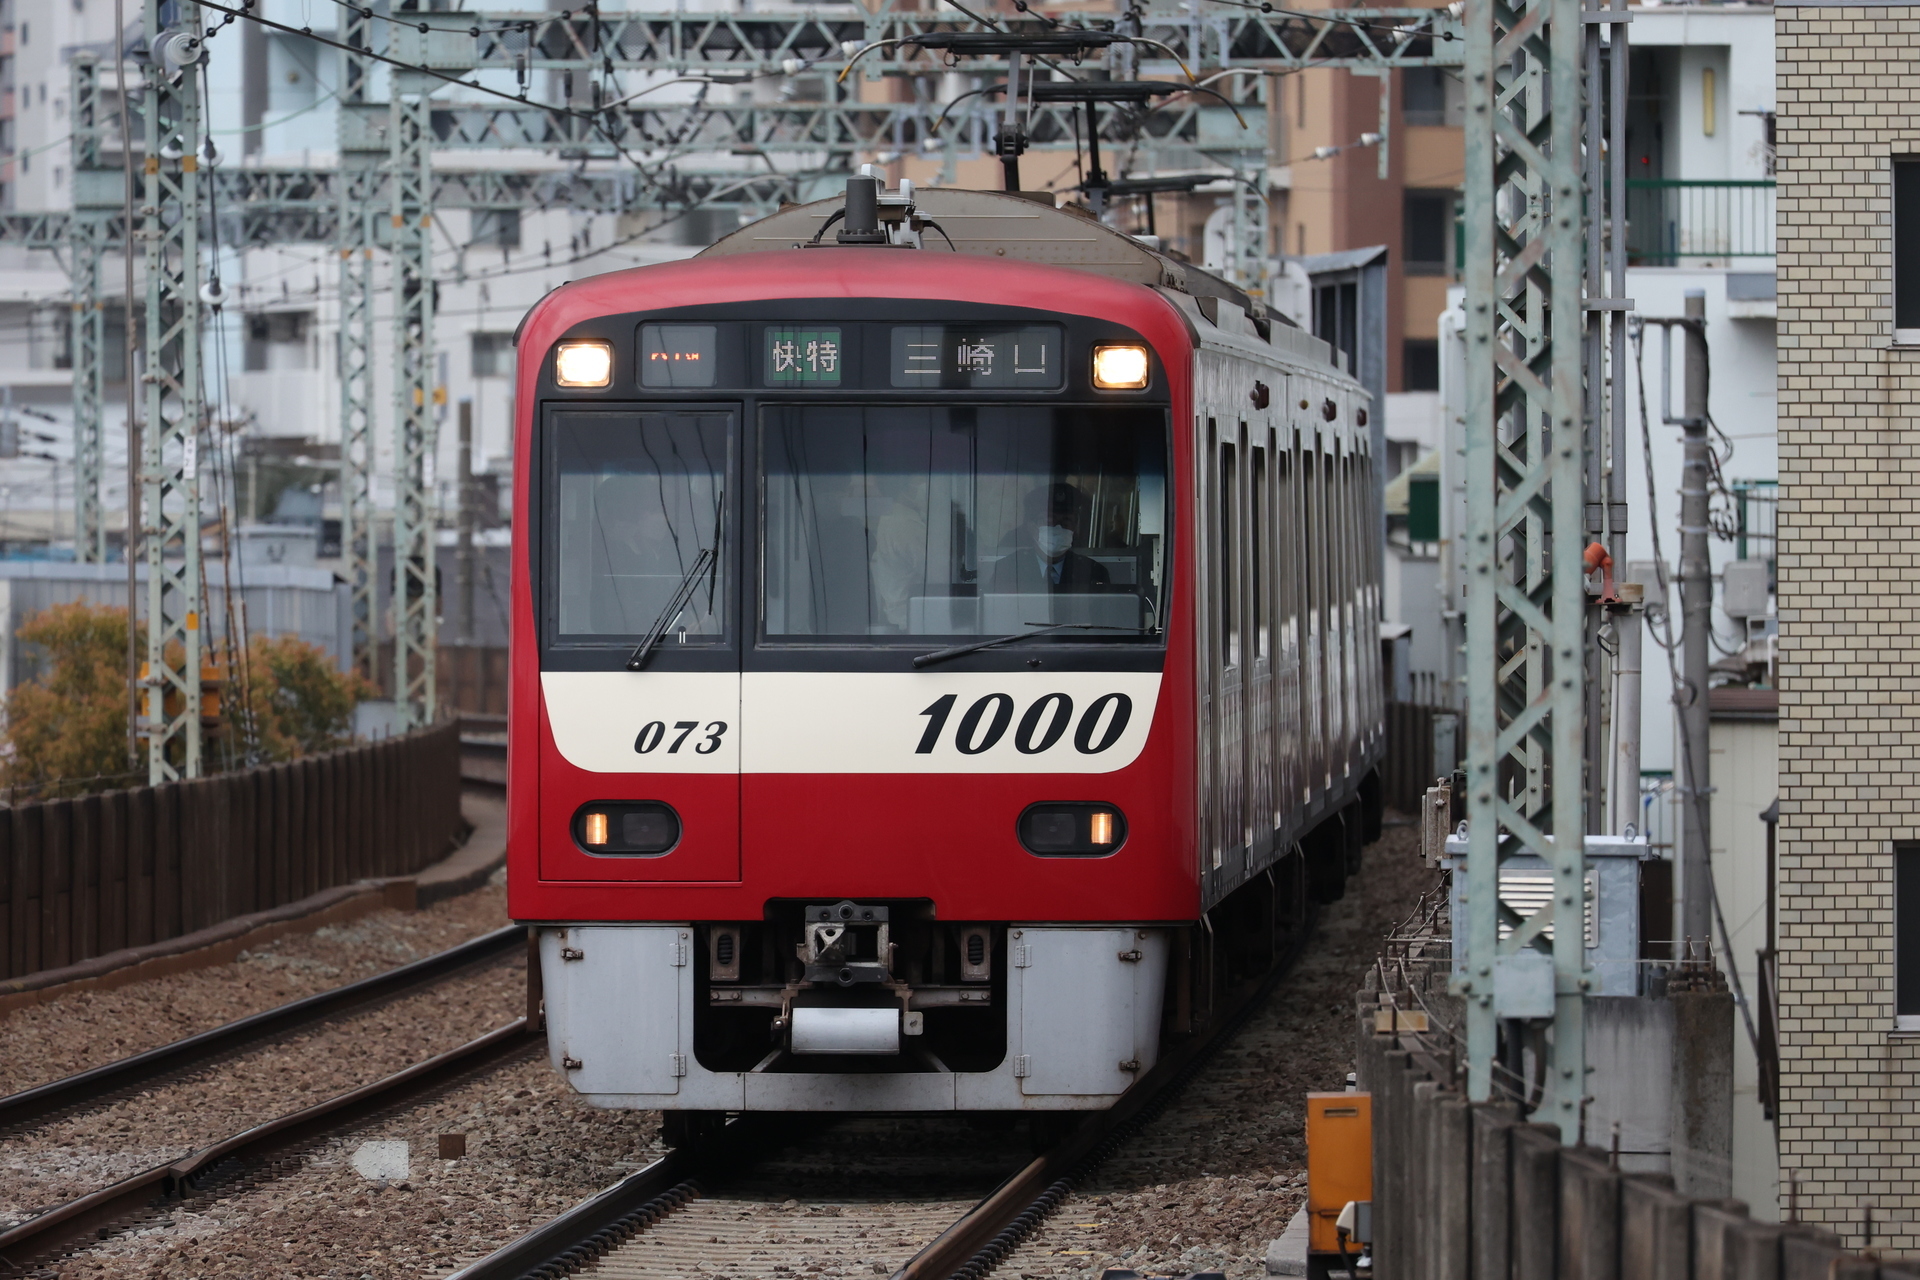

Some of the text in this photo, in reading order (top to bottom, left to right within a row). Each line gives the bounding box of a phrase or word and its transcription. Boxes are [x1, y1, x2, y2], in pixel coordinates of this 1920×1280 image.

[773, 340, 838, 372] 快特
[634, 720, 728, 754] 073
[914, 692, 1133, 755] 1000
